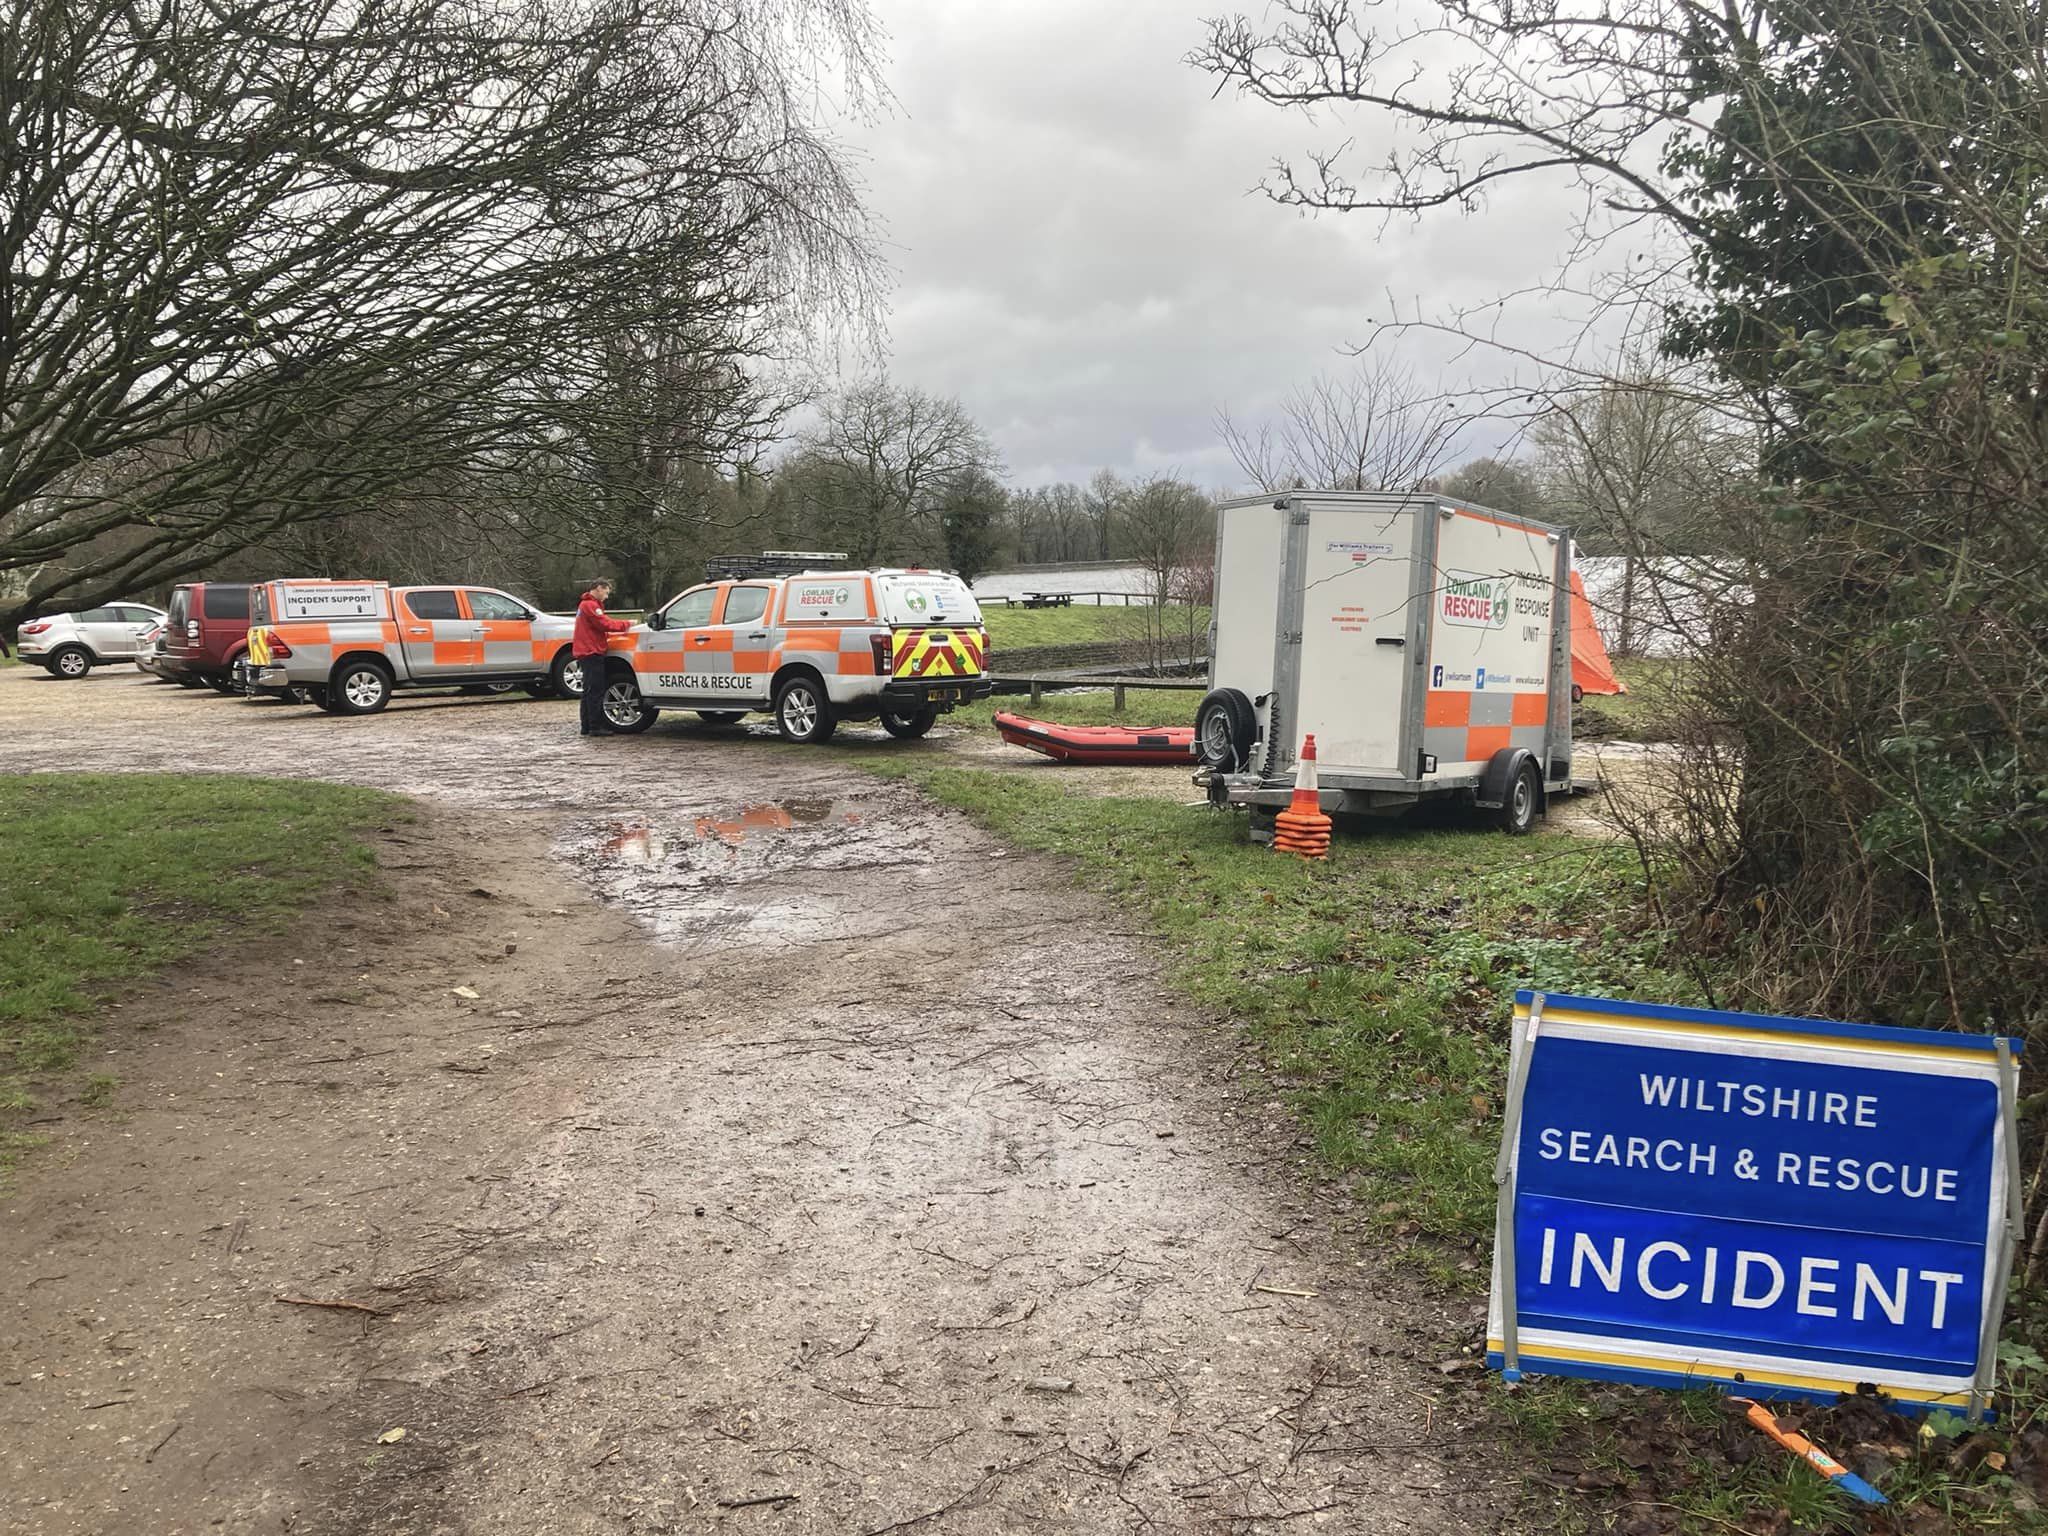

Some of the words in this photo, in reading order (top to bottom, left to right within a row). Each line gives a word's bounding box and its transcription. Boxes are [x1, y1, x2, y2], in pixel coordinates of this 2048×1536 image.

[1446, 577, 1491, 599] LOWLAND
[1517, 570, 1550, 591] INCIDENT
[288, 596, 329, 604] INCIDENT
[331, 595, 372, 603] SUPPORT
[800, 596, 834, 605] RESCUE
[1444, 595, 1492, 621] RESCUE
[1515, 597, 1550, 618] RESPONSE
[1522, 625, 1540, 642] UNIT
[659, 675, 698, 688] SEARCH
[700, 676, 709, 689] &
[711, 676, 752, 689] RESCUE
[1639, 1073, 1878, 1129] WILTSHIRE
[1538, 1128, 1717, 1176] SEARCH
[1733, 1149, 1760, 1181] &
[1777, 1152, 1959, 1202] RESCUE
[1539, 1228, 1964, 1330] INCIDENT
